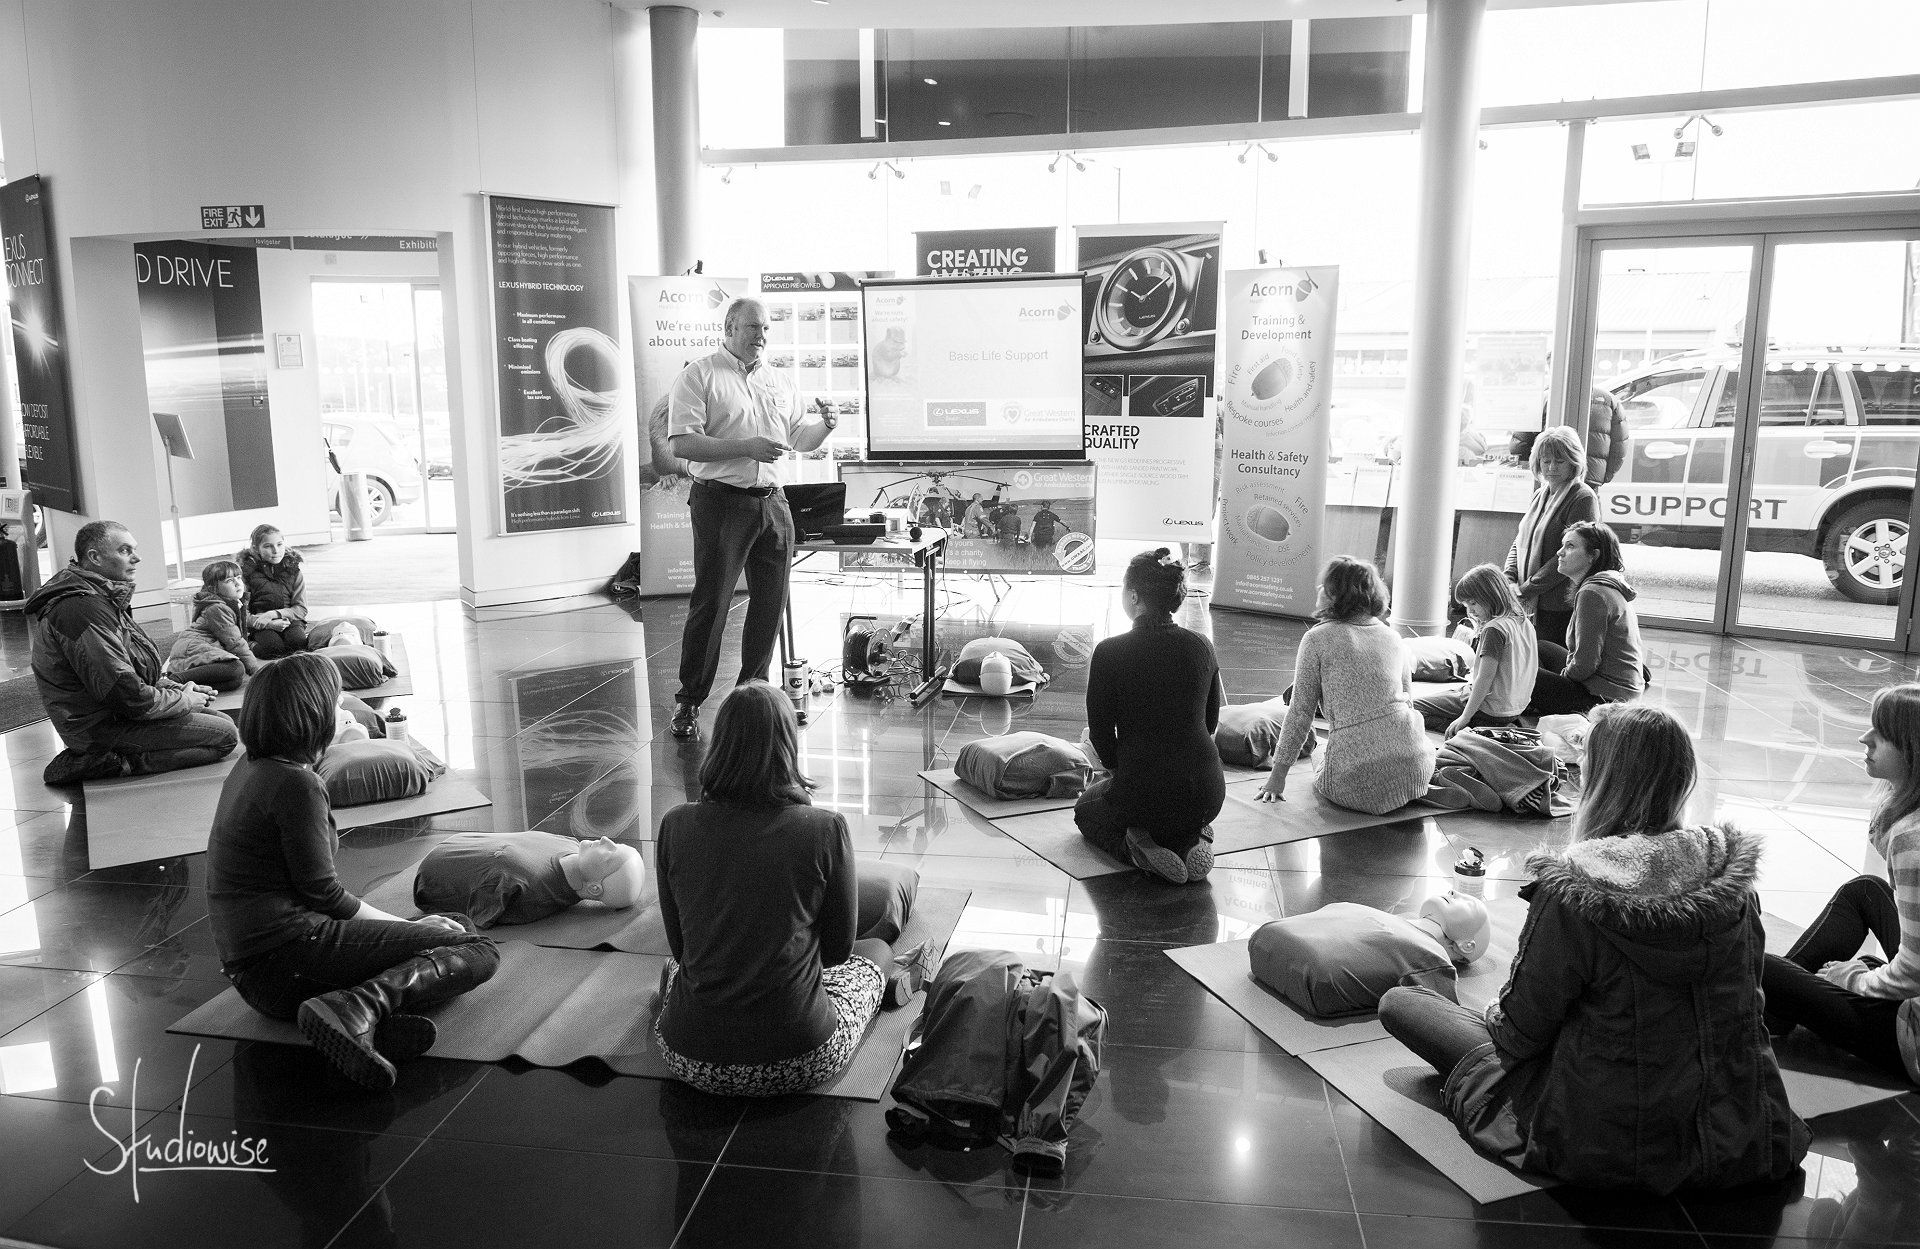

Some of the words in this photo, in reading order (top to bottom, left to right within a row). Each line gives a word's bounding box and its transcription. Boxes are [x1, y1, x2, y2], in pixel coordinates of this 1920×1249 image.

[202, 208, 224, 218] FIRE
[548, 209, 578, 218] performance
[203, 218, 225, 227] EXIT
[4, 233, 26, 261] EXUS
[927, 247, 1029, 268] CREATING
[157, 255, 234, 288] DRIVE
[498, 281, 520, 289] LEXUS
[520, 282, 542, 290] HYBRID
[542, 283, 584, 292] TECHNOLOGY
[1250, 283, 1293, 297] Acorn
[659, 289, 703, 303] Acorn
[1018, 307, 1055, 318] Acorn
[656, 320, 691, 331] We're
[694, 321, 723, 331] nuts
[1252, 315, 1295, 327] Training
[1298, 314, 1305, 325] &
[648, 335, 687, 347] about
[1241, 329, 1312, 342] Development
[949, 351, 978, 361] Basic
[982, 351, 1001, 361] Life
[1005, 349, 1049, 363] Support
[1227, 364, 1242, 385] Fire
[1247, 362, 1258, 375] First
[1284, 397, 1304, 412] Health
[1303, 383, 1313, 399] and
[1308, 361, 1316, 383] safety
[22, 403, 31, 416] OW
[1226, 400, 1253, 426] Bespoke
[1253, 417, 1284, 428] courses
[1084, 424, 1140, 437] CRAFTED
[1084, 437, 1139, 449] QUALITY
[1231, 449, 1266, 461] Health
[1268, 450, 1275, 461] &
[1277, 451, 1309, 465] Safety
[1033, 472, 1057, 482] Great
[1059, 472, 1094, 482] Western
[1238, 463, 1301, 479] Consultancy
[1235, 483, 1248, 494] Risk
[1250, 481, 1286, 494] assessment
[1254, 493, 1284, 506] Retained
[1282, 504, 1302, 528] services
[1294, 496, 1309, 515] Fire
[1610, 494, 1788, 520] SUPPORT
[656, 511, 685, 520] Training
[650, 522, 674, 530] Health
[1226, 526, 1239, 545] work
[955, 540, 974, 548] yours
[961, 550, 984, 558] charity
[1246, 550, 1267, 567] Policy
[1269, 544, 1313, 567] development
[969, 558, 987, 567] flying
[1235, 588, 1293, 600] www.acornsafety.co.uk
